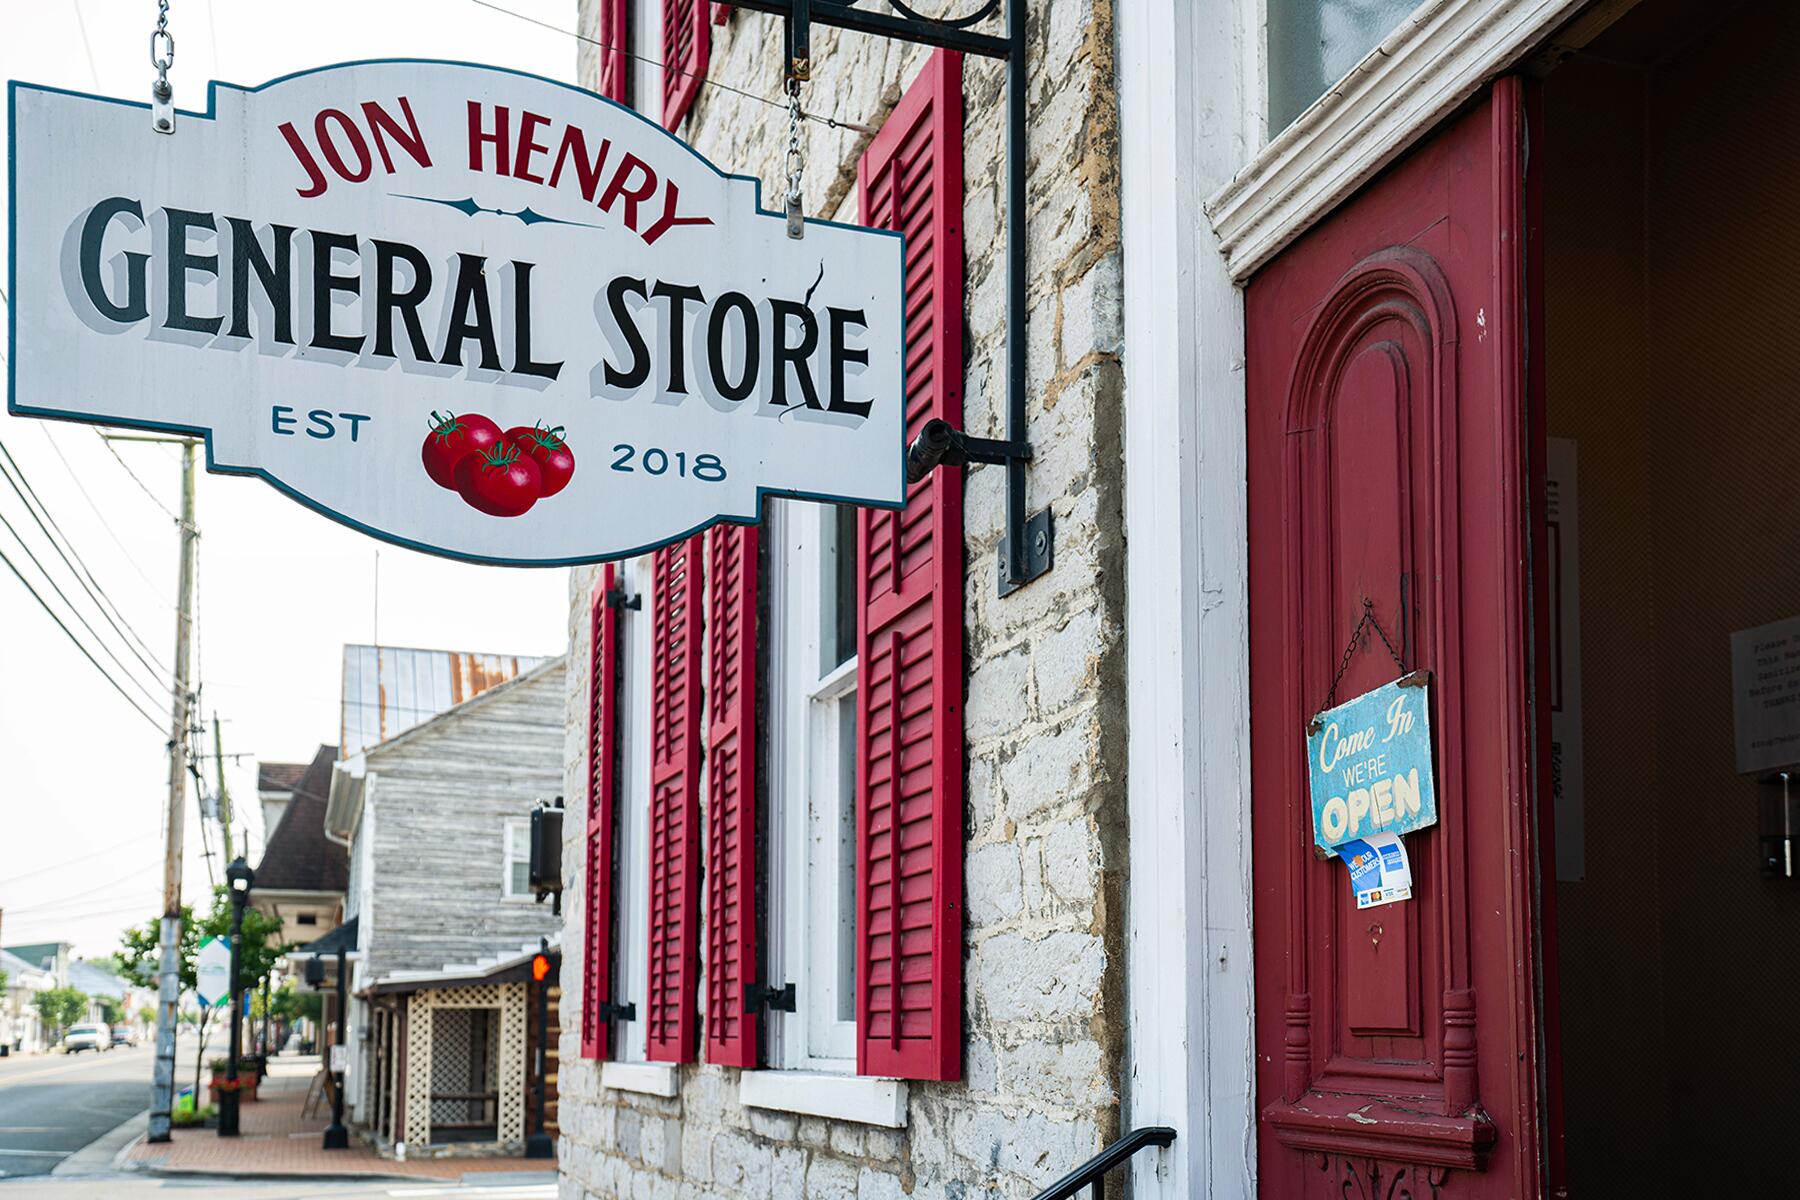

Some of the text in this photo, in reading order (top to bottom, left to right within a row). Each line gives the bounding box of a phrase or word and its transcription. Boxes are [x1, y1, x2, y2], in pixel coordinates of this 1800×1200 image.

[277, 96, 715, 246] JON HENRY
[78, 196, 875, 420] GENERAL STORE
[272, 405, 371, 442] EST
[610, 443, 728, 482] 2018
[1319, 693, 1416, 773] Come In
[1342, 754, 1388, 788] WE'RE
[1321, 767, 1422, 844] OPEN
